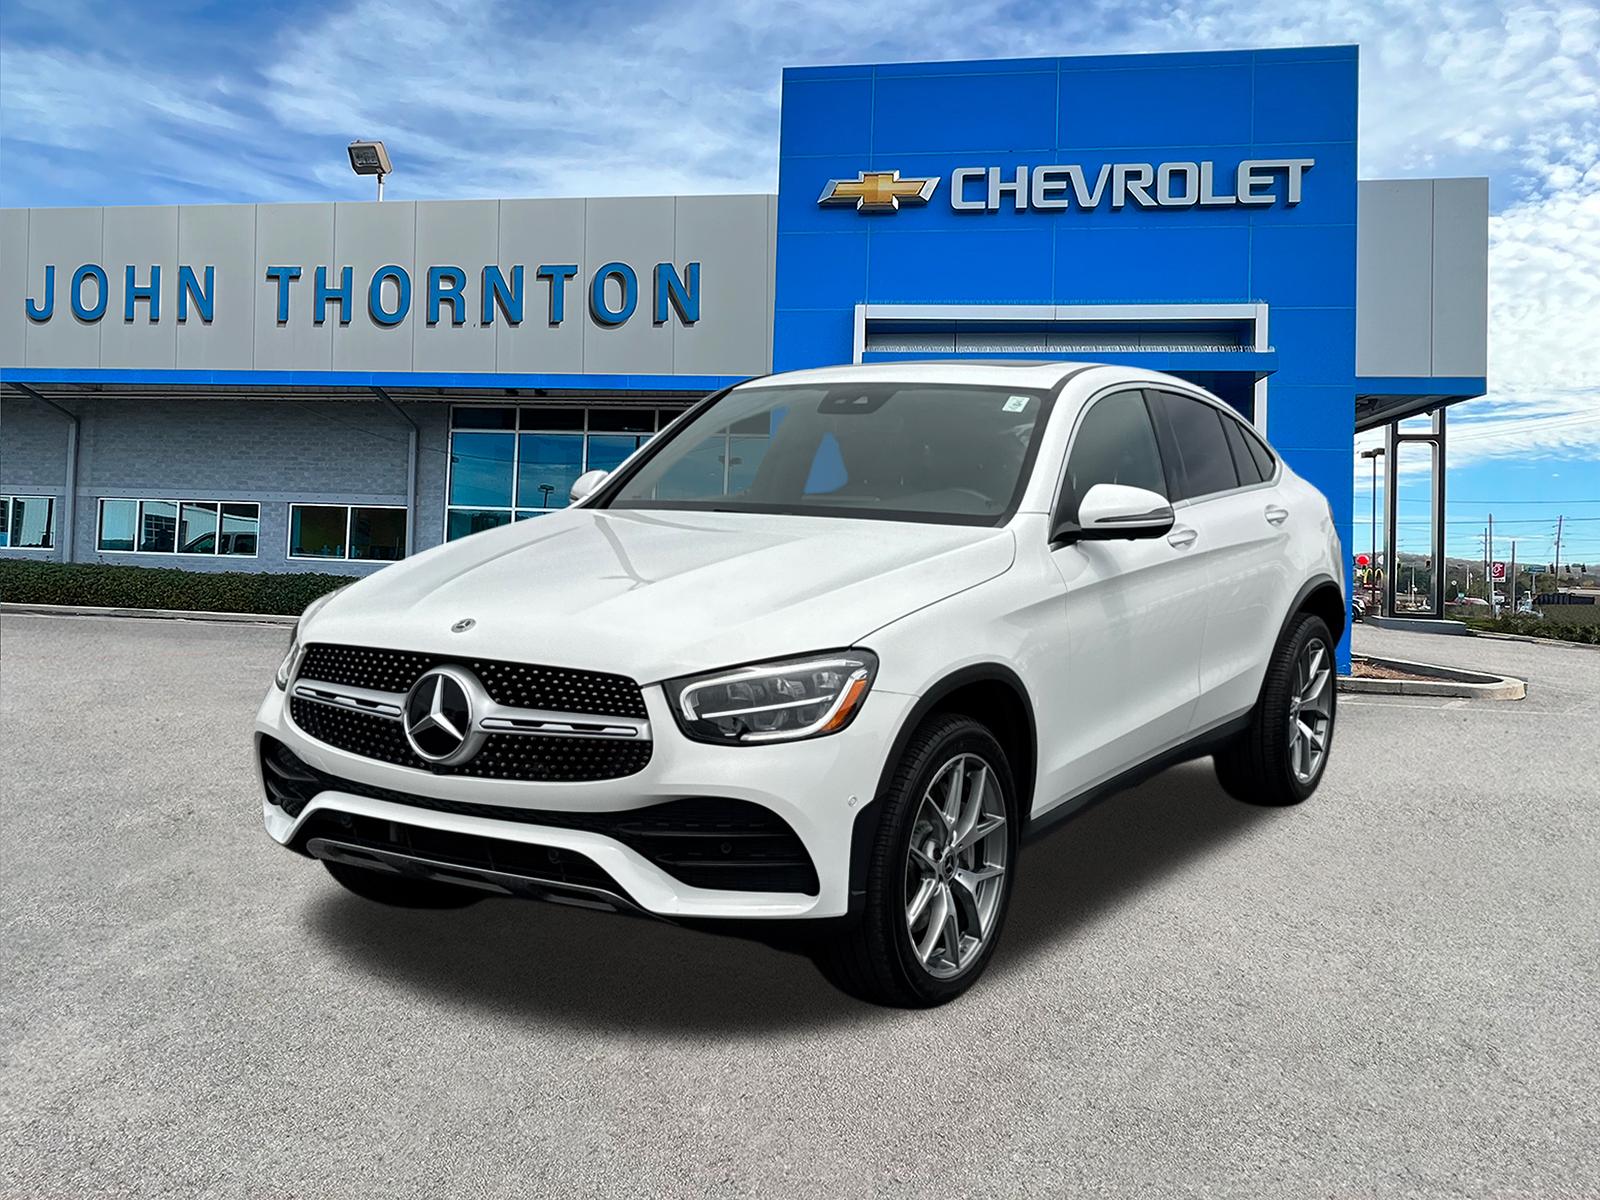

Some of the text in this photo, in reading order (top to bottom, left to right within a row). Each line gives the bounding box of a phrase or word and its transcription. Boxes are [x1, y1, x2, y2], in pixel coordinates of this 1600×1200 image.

[951, 158, 1315, 211] CHEVROLET
[25, 262, 701, 327] JOHN THORNTON
